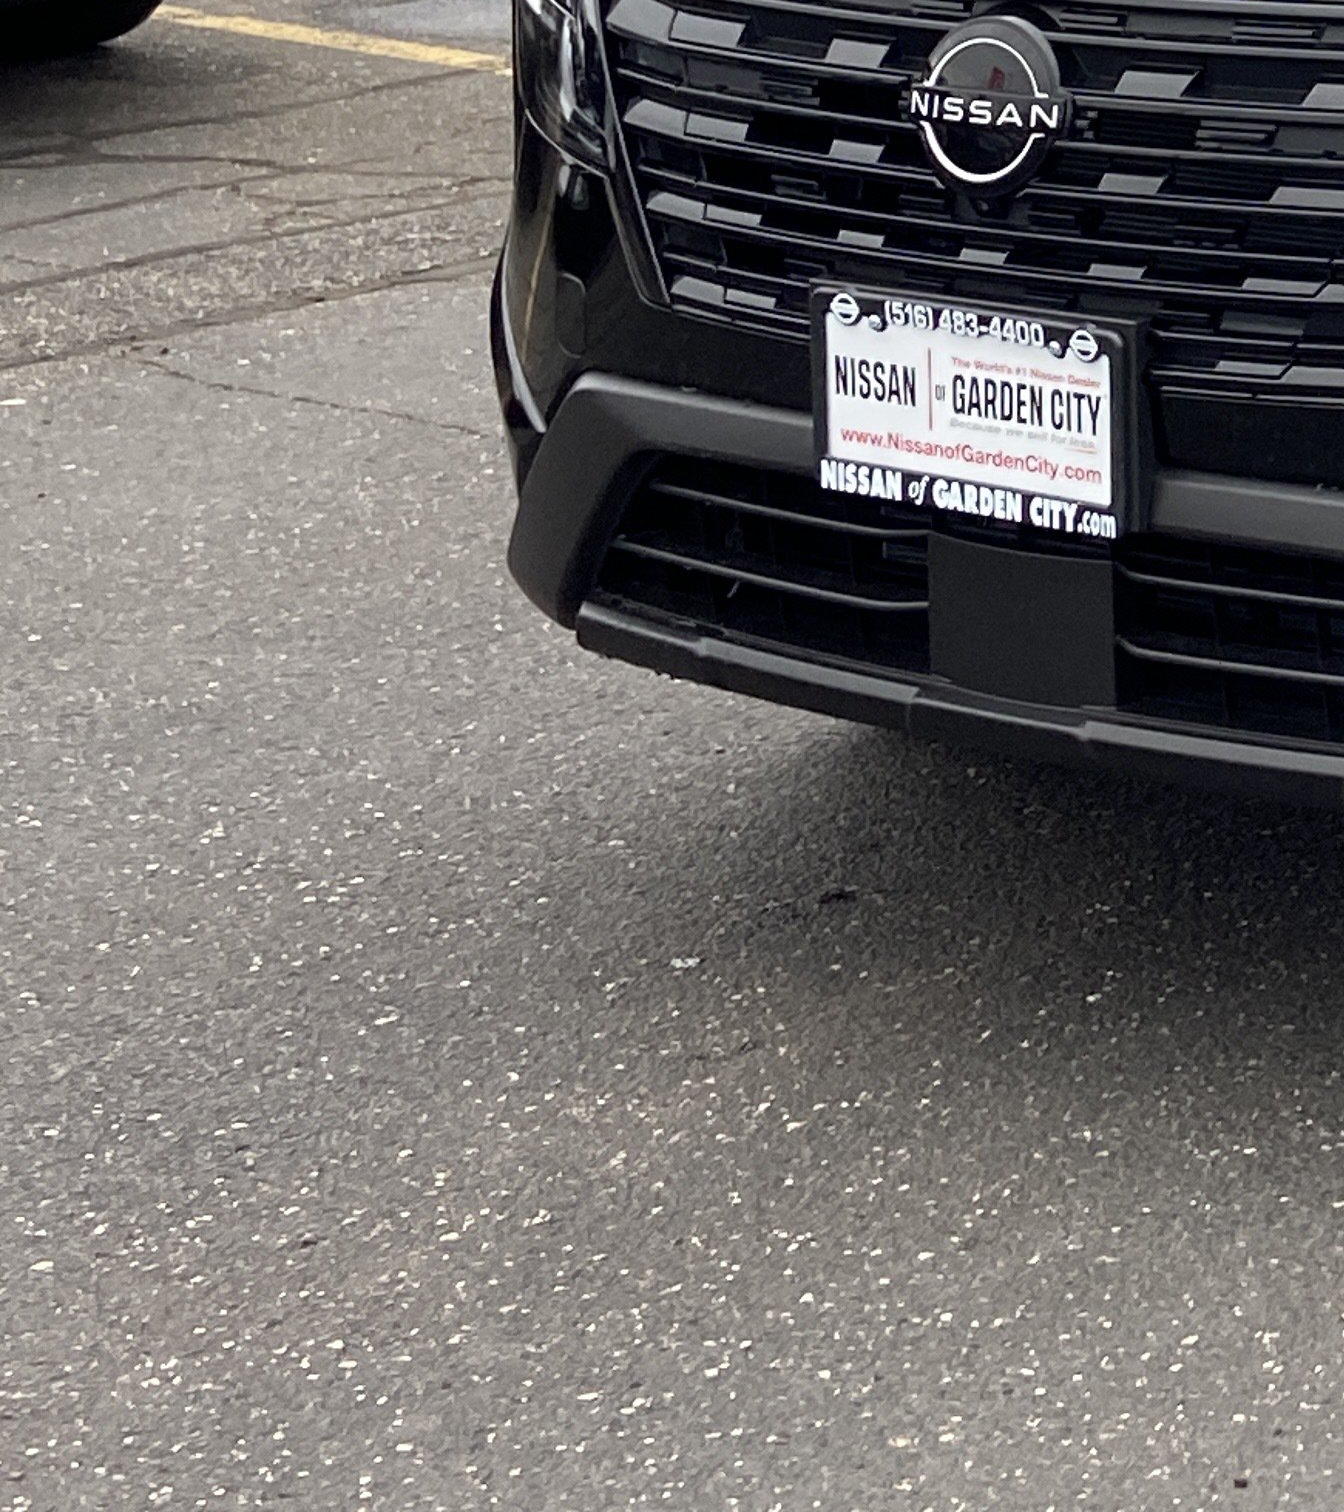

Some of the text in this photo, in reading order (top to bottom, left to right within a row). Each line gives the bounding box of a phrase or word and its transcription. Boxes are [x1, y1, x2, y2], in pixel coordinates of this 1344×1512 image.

[911, 91, 1059, 128] NISSAN
[884, 300, 1045, 347] (516) 483-4400
[836, 356, 917, 406] NISSAN
[952, 374, 1043, 427] GARDEN
[1051, 388, 1101, 437] CITY
[841, 428, 1102, 484] www.NissanofGardenCity.com
[820, 459, 1117, 539] NISSAN of GARDEN CITY.com
